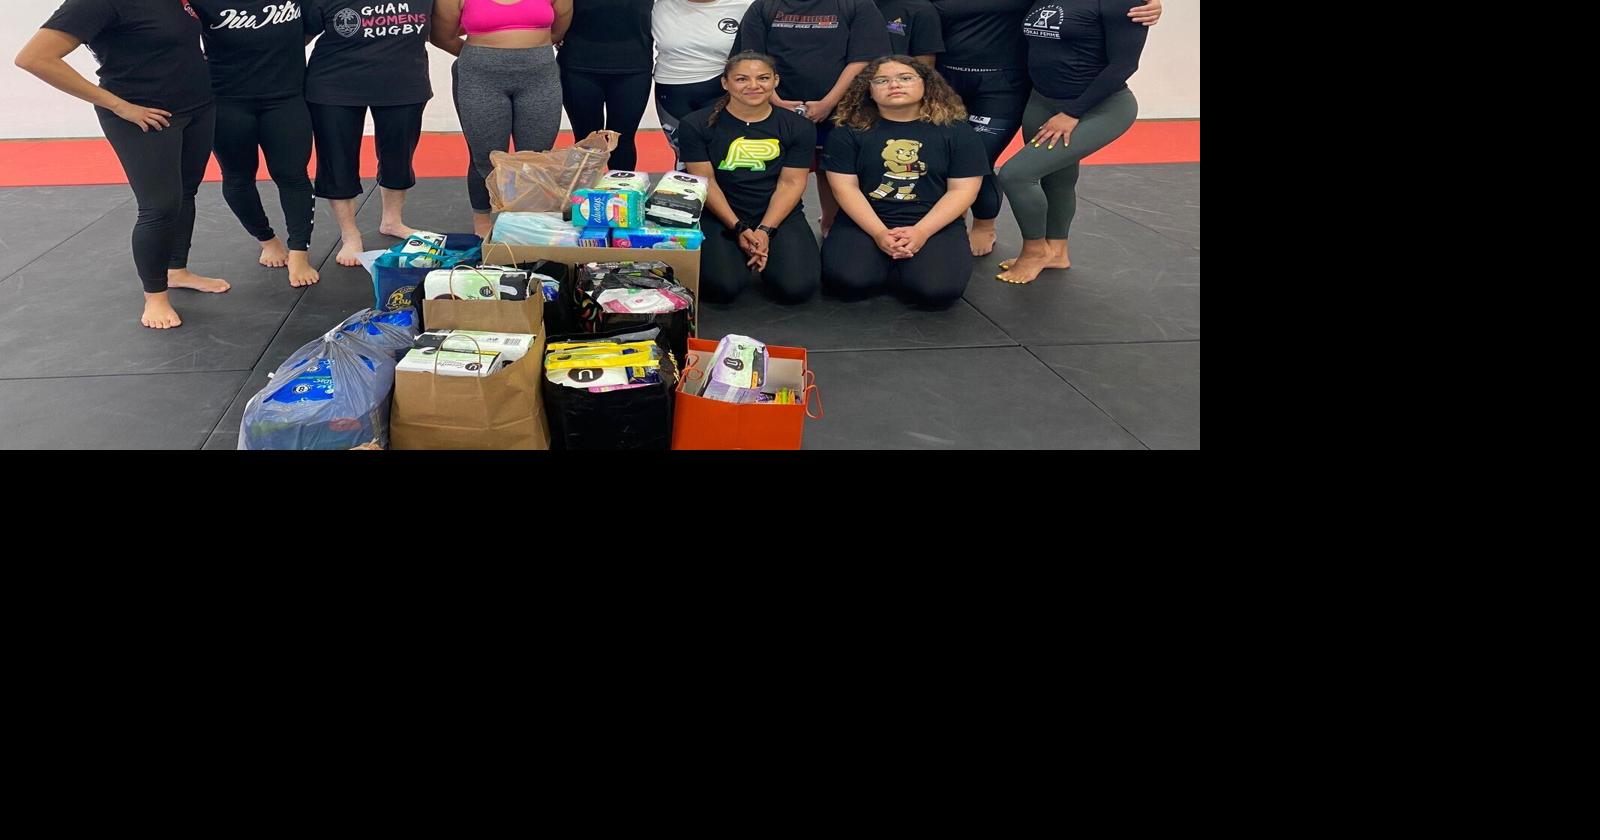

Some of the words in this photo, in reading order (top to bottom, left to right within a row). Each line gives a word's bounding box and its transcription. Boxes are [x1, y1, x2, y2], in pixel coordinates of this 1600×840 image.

[361, 2, 410, 17] GUAM
[210, 9, 257, 30] Jiu
[361, 13, 428, 28] WOMENS
[363, 23, 425, 39] RUGBY
[594, 197, 602, 224] always
